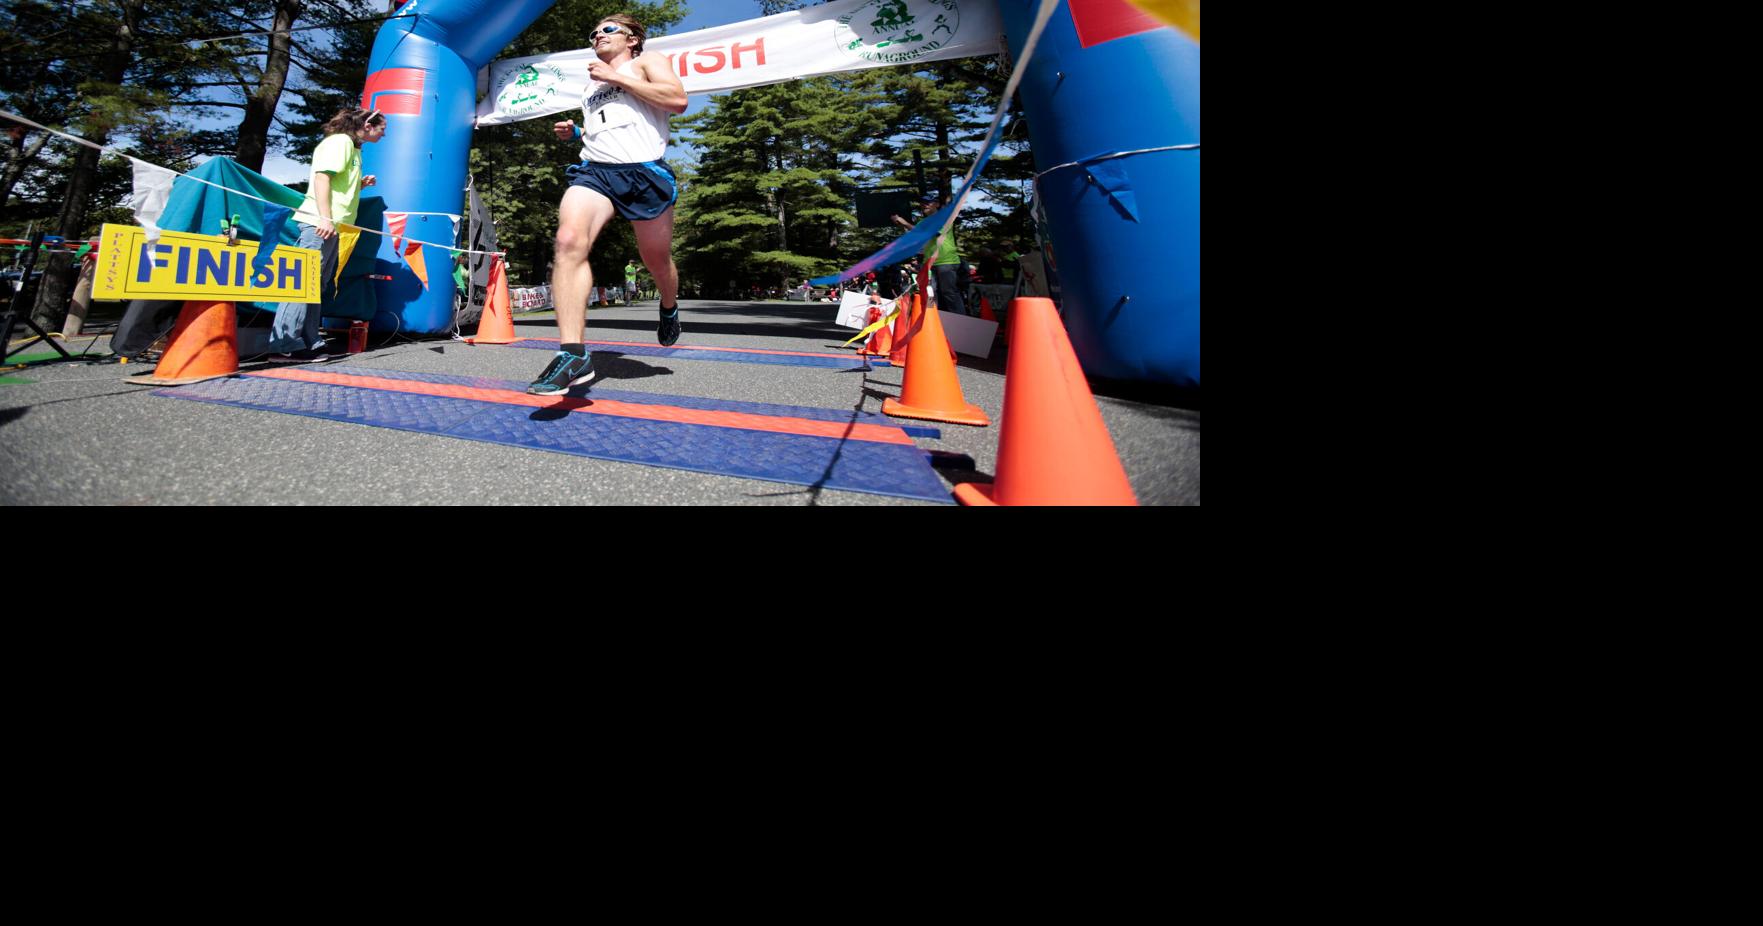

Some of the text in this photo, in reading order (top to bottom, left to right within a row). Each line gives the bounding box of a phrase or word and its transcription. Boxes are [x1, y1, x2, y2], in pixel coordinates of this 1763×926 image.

[667, 37, 766, 77] ISH
[598, 109, 606, 123] 1
[136, 243, 302, 290] FINISH
